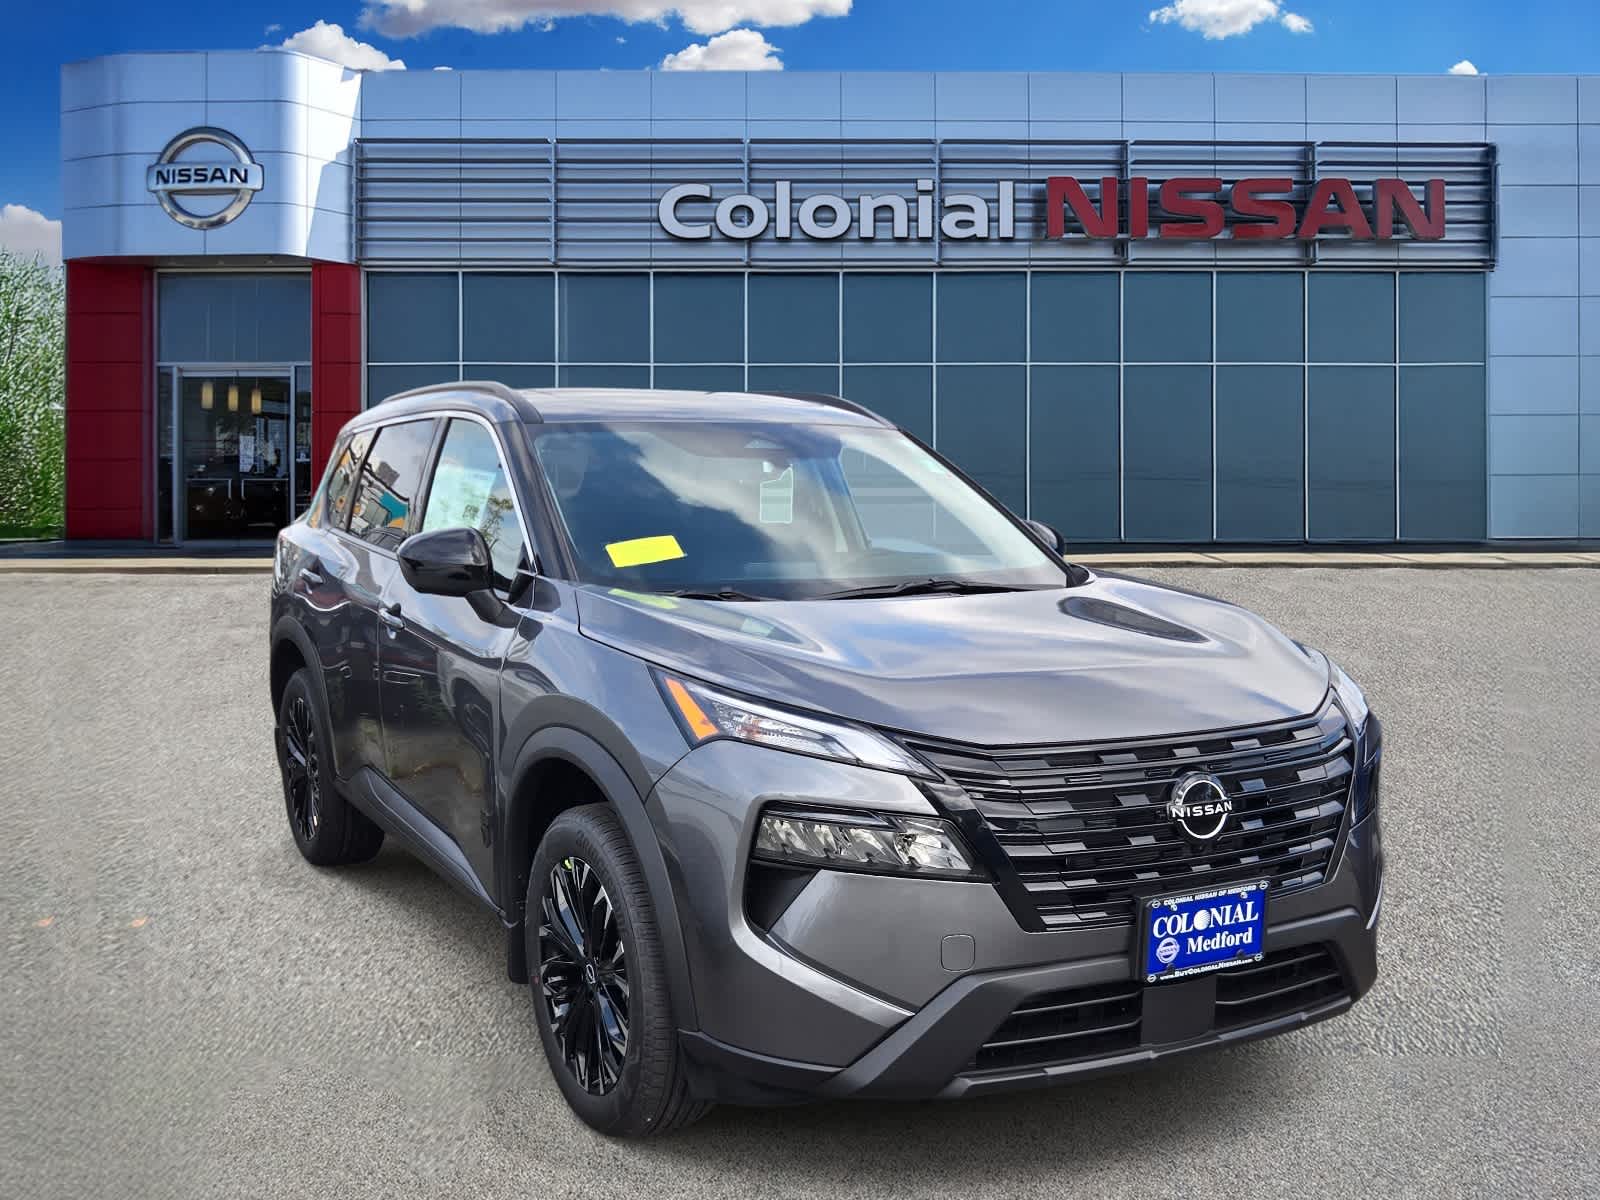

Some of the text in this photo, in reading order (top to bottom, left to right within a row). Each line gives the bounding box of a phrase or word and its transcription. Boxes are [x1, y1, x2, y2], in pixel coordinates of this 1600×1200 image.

[155, 167, 249, 185] NISSAN
[658, 176, 1446, 240] Colonial NISSAN
[1171, 800, 1233, 818] NISSAN
[1163, 894, 1194, 906] COLONIAL
[1194, 891, 1218, 901] NISSAN
[1218, 888, 1226, 897] OF
[1153, 901, 1259, 938] COLONIAL
[1186, 927, 1253, 955] Medford
